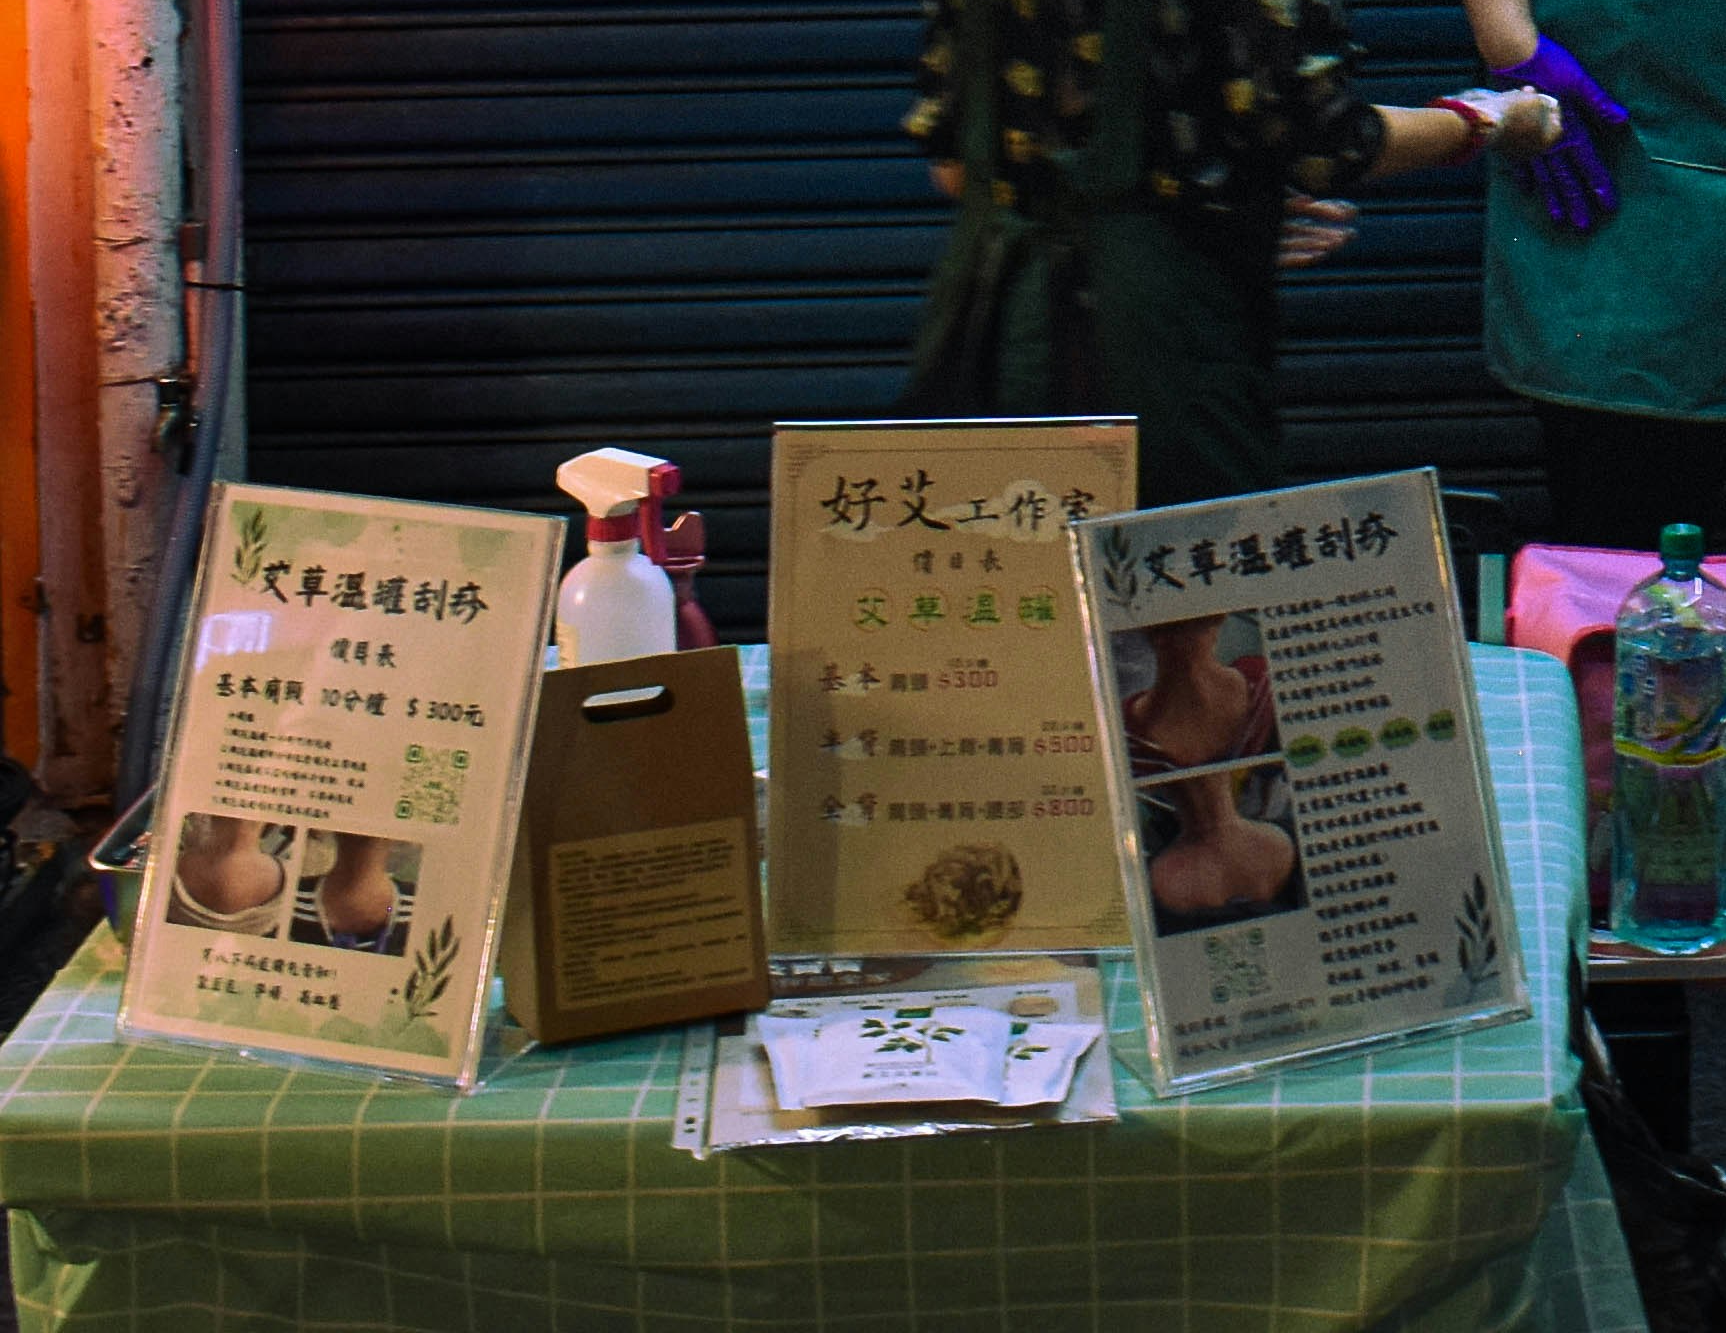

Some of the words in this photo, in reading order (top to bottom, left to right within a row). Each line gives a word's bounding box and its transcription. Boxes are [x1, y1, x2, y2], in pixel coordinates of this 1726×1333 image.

[820, 470, 1094, 531] 好艾工作室
[937, 670, 999, 689] $300
[1033, 735, 1095, 756] $500
[1032, 798, 1095, 819] $800
